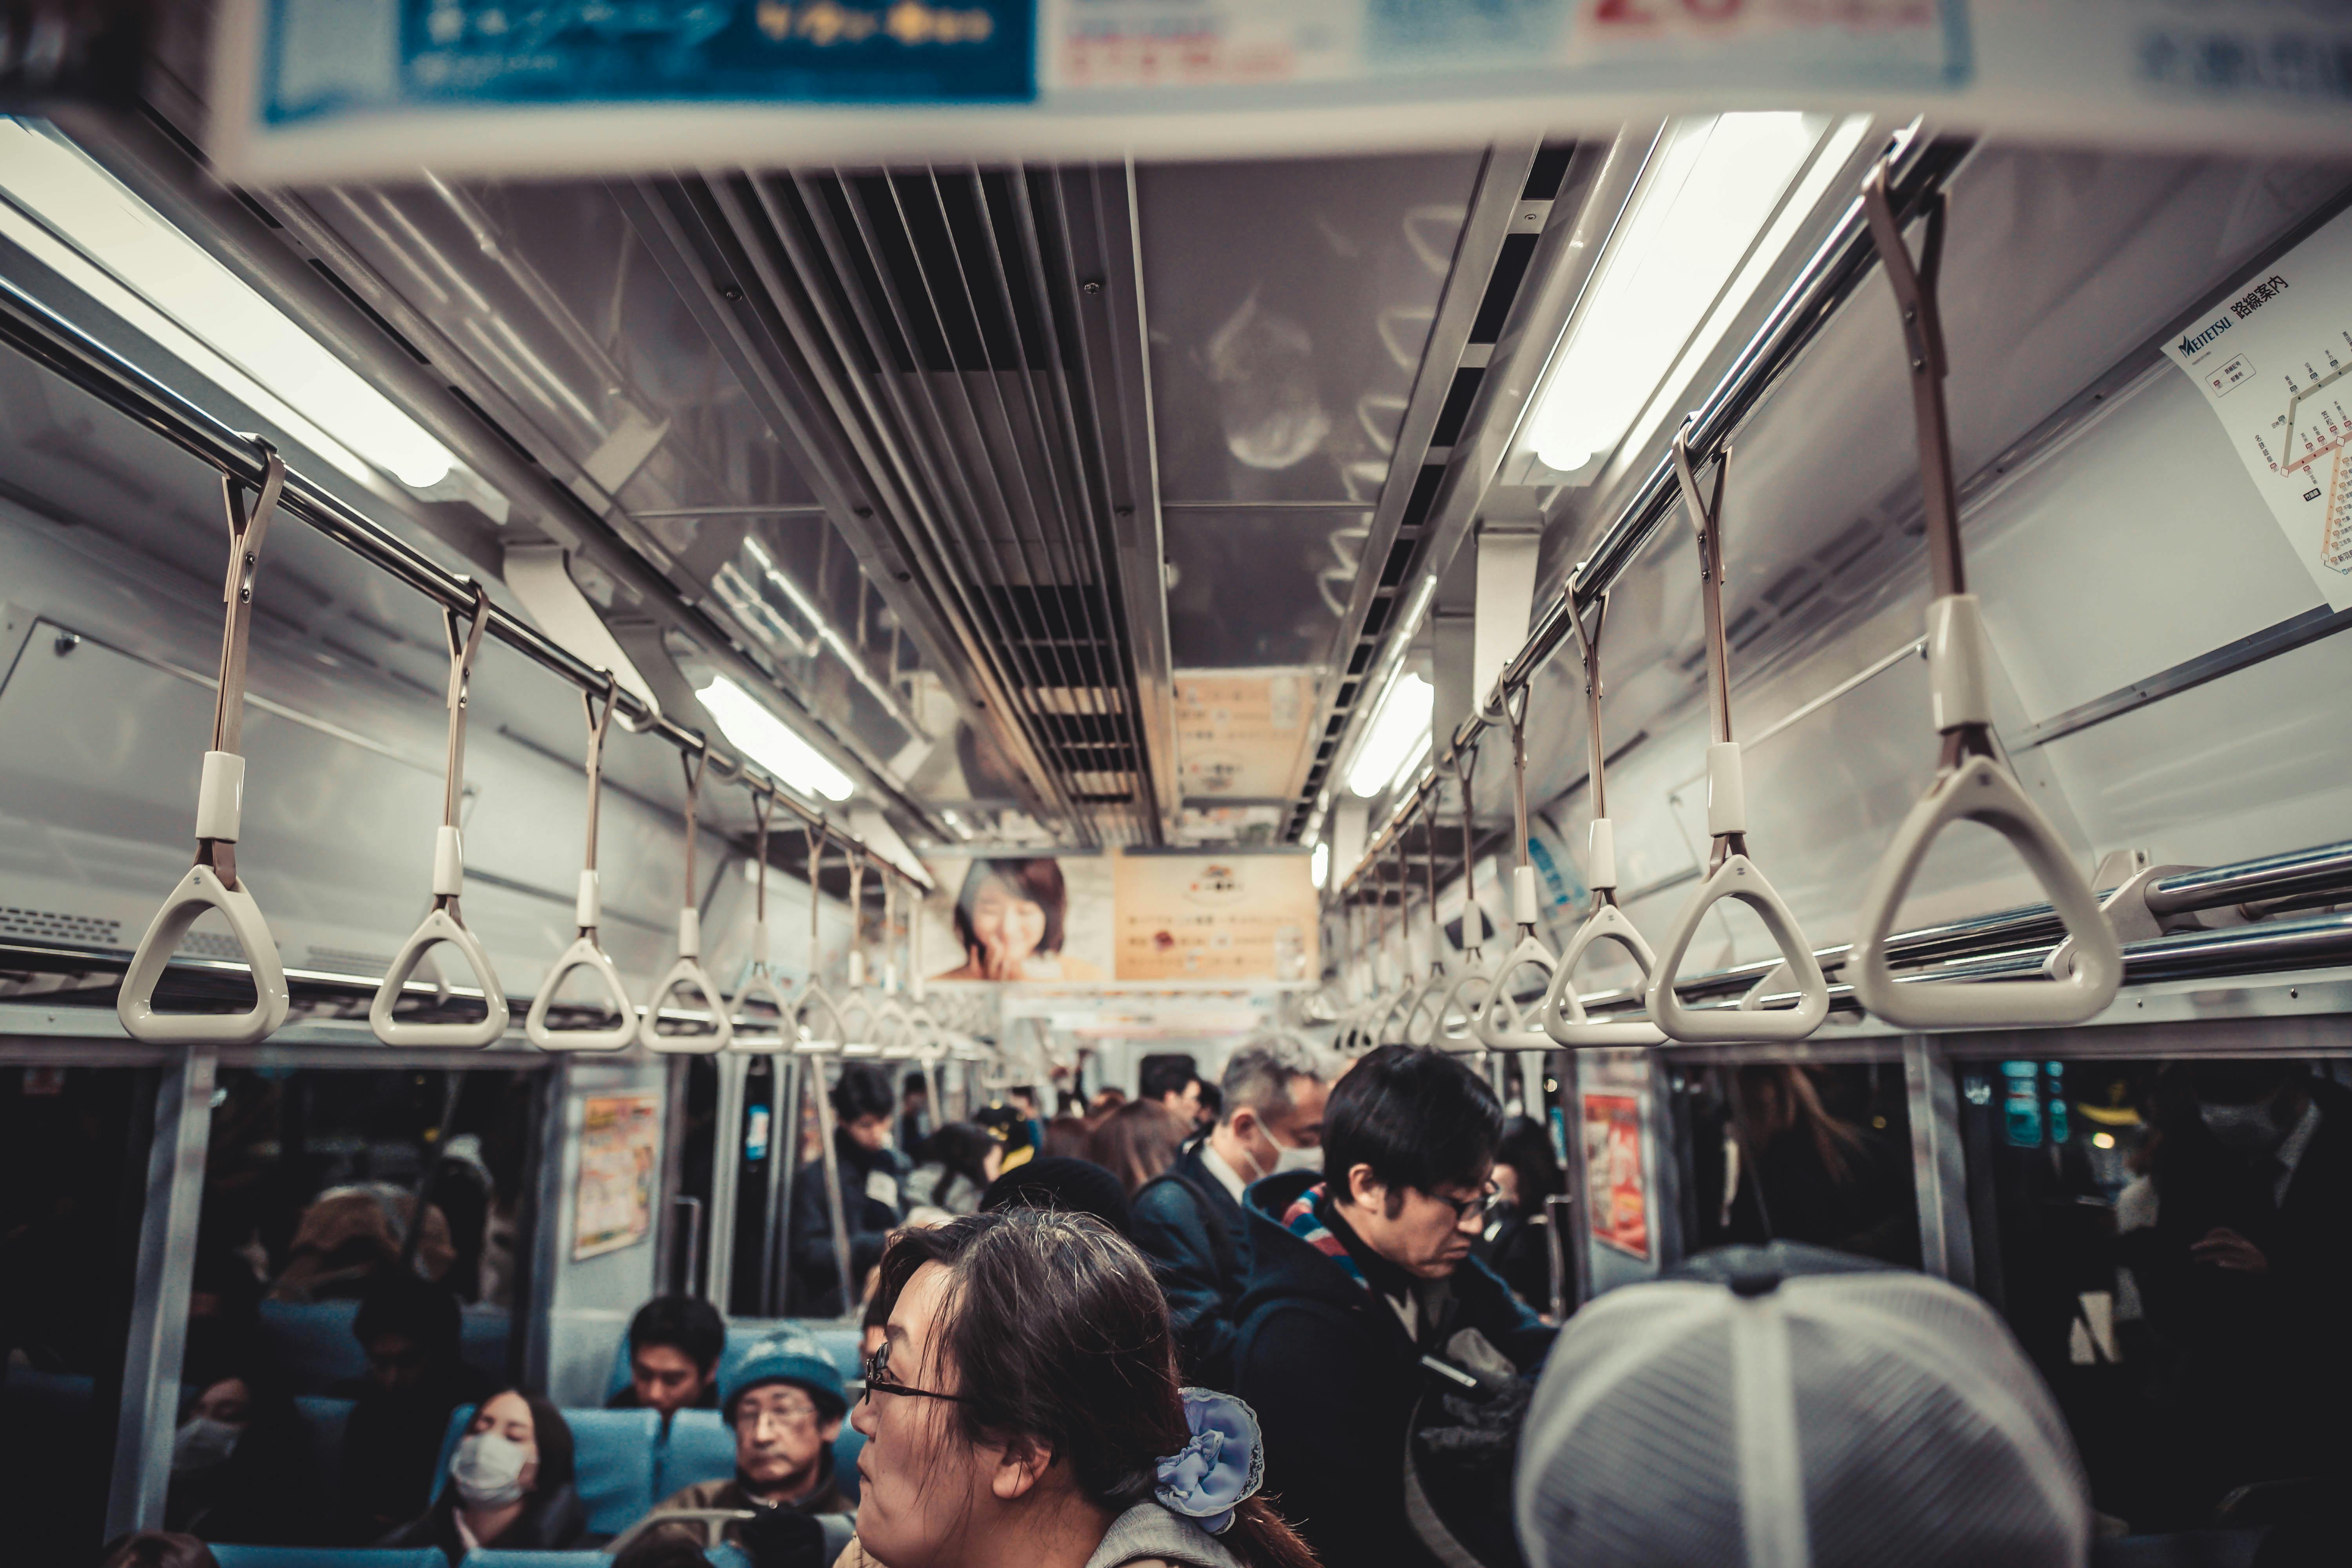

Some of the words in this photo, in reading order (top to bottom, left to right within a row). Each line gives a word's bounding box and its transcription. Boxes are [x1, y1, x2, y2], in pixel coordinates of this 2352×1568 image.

[2230, 275, 2289, 319] 路線案内
[2178, 316, 2232, 358] MEITETSU
[2321, 410, 2334, 426] 笠松
